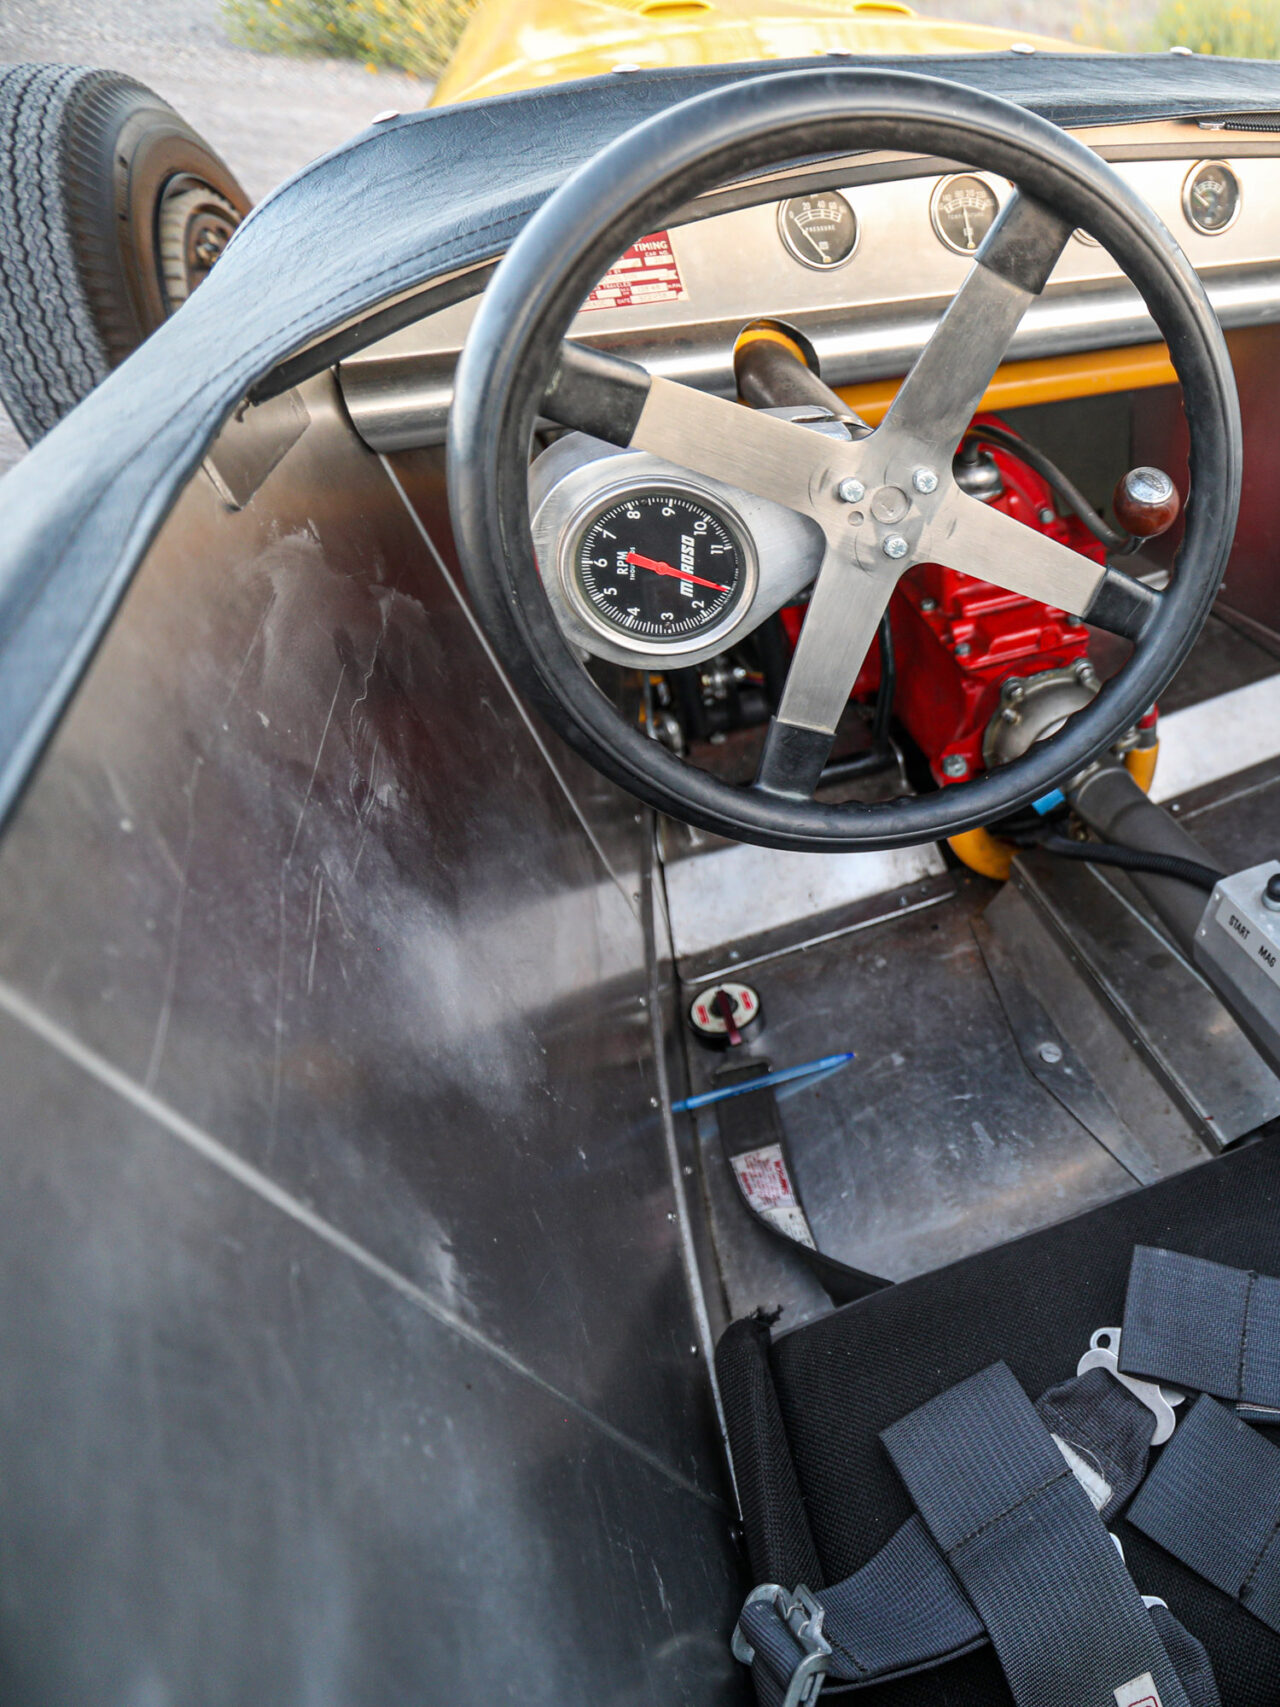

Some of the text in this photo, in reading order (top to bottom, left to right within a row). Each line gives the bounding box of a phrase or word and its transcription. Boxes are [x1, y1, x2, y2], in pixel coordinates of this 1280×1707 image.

[802, 202, 811, 210] 20
[632, 241, 668, 252] TIMING
[627, 510, 641, 520] 8
[662, 507, 676, 517] 9
[693, 521, 707, 536] 10
[602, 529, 617, 540] 7
[710, 544, 724, 555] 11
[593, 558, 608, 568] 6
[616, 551, 629, 575] RPM
[604, 587, 618, 596] 5
[691, 600, 705, 608] 2
[628, 607, 640, 617] 4
[661, 612, 674, 621] 3
[1228, 915, 1250, 940] START
[1258, 945, 1277, 968] MAG
